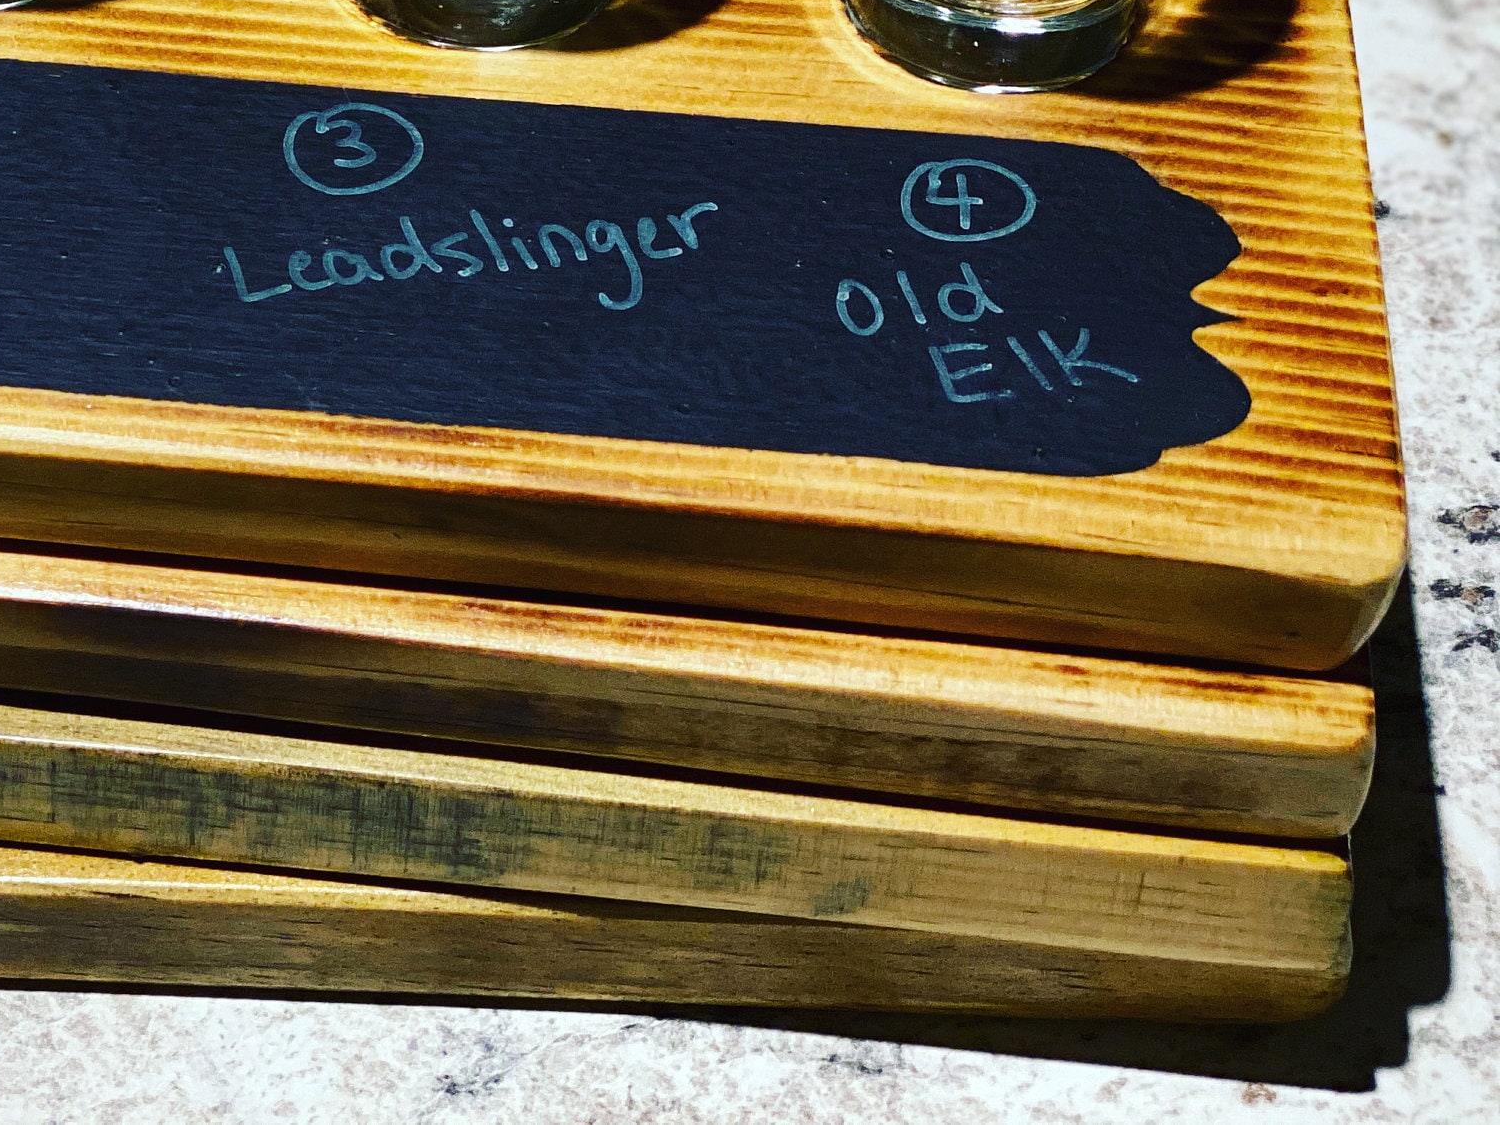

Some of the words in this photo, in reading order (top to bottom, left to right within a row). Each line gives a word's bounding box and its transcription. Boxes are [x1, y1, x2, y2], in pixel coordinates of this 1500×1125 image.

[323, 118, 377, 169] 3
[926, 167, 984, 231] 4
[222, 201, 719, 312] Leadslinger
[835, 261, 1005, 337] Old
